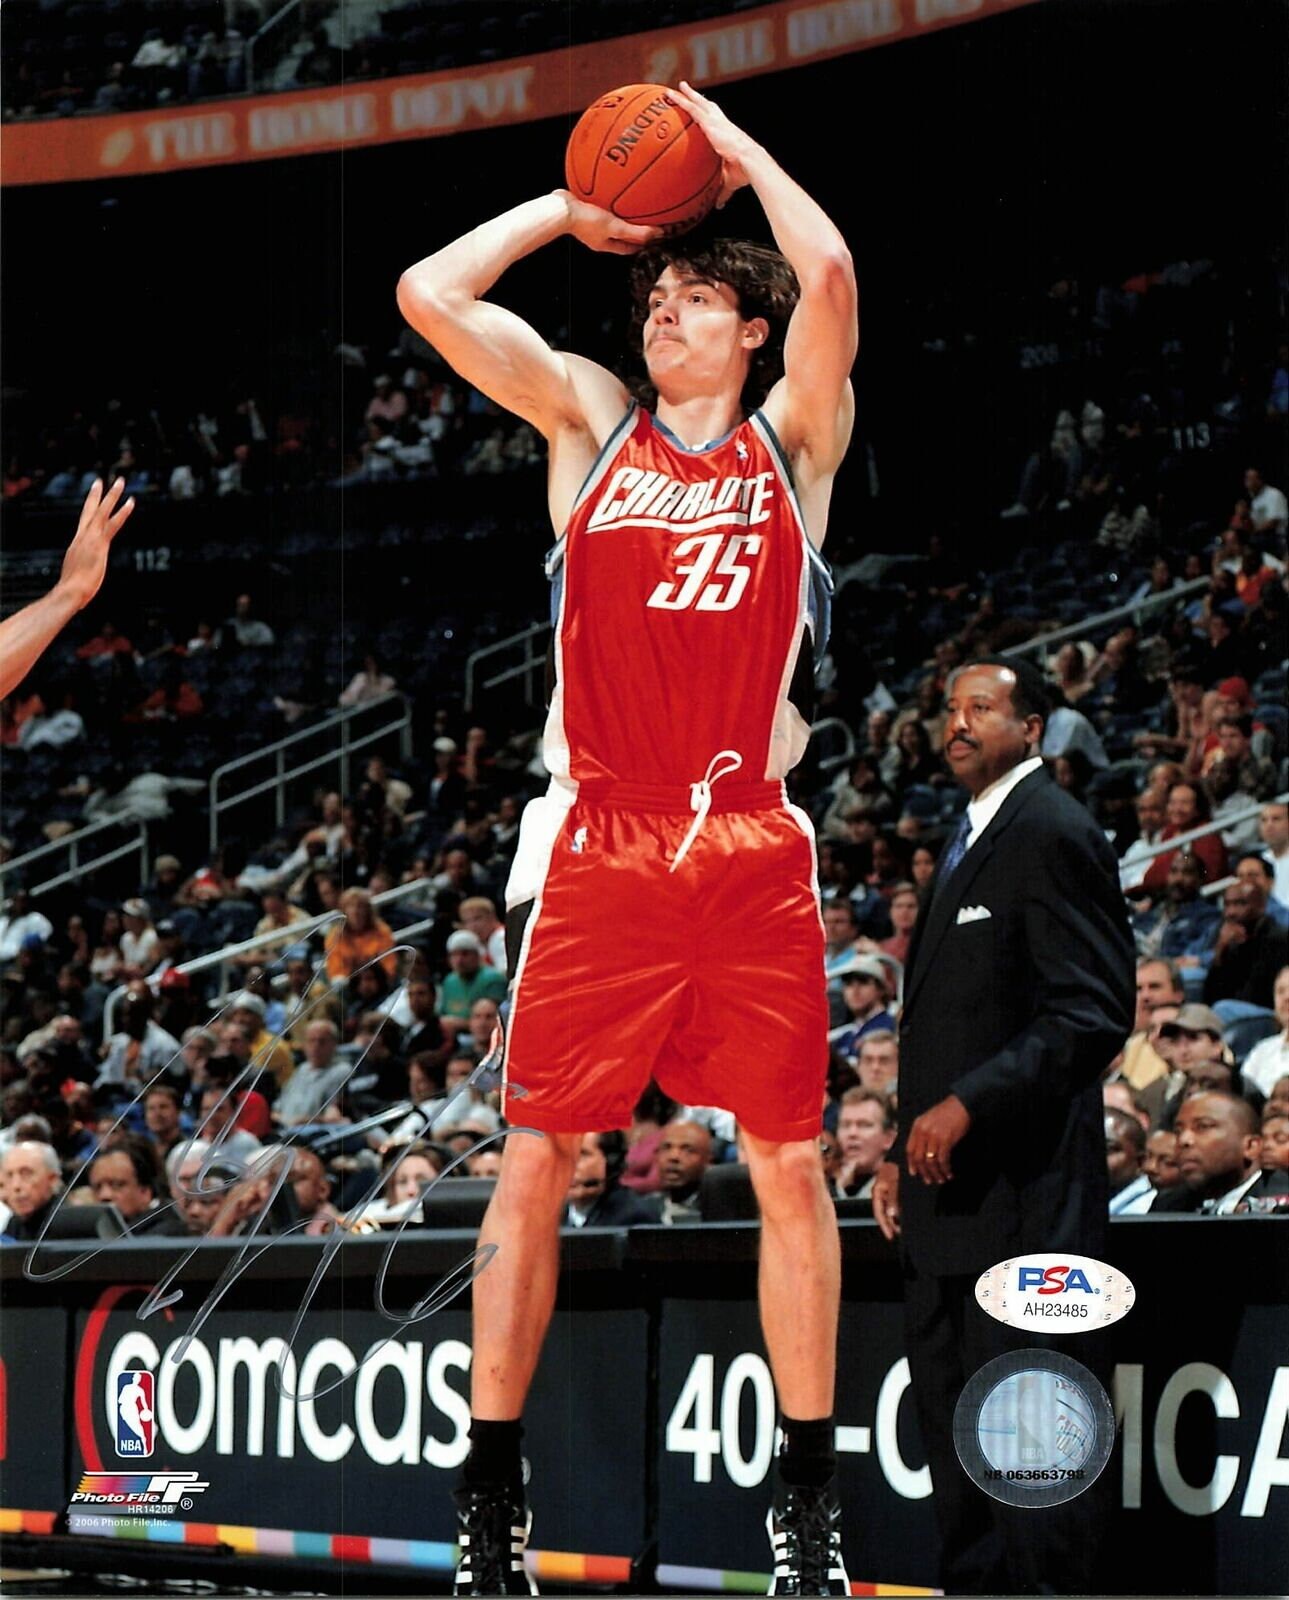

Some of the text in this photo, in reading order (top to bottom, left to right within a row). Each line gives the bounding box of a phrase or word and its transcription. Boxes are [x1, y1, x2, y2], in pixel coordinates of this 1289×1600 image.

[135, 547, 171, 572] 112
[646, 534, 762, 611] 35
[1018, 1266, 1093, 1294] PSA
[1023, 1302, 1088, 1318] AH23485
